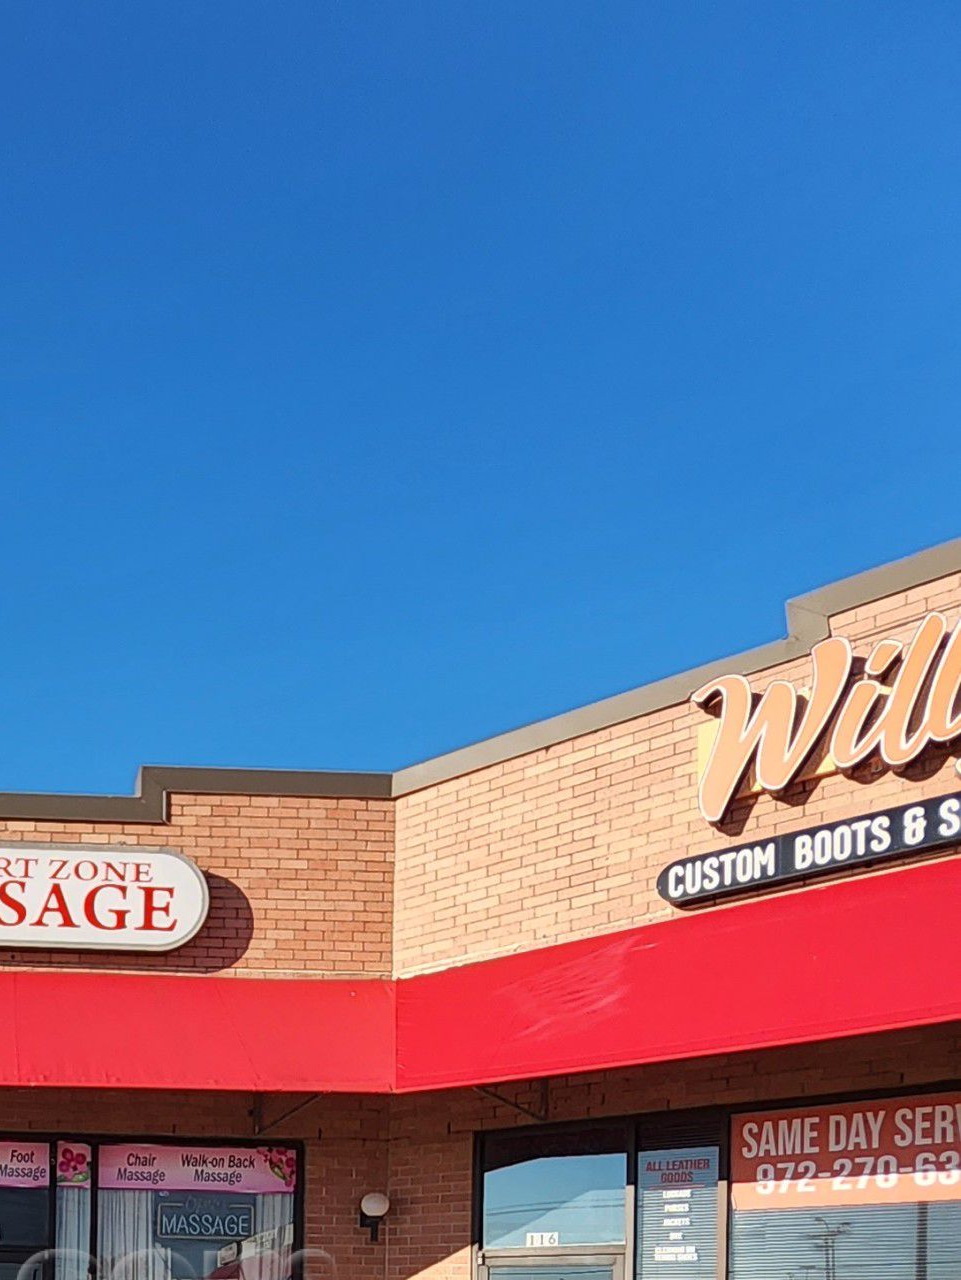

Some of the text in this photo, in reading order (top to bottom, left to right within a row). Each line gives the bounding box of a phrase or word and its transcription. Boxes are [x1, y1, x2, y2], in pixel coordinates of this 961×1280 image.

[668, 843, 776, 898] CUSTOM
[794, 816, 891, 870] BOOTS
[903, 806, 927, 846] &
[49, 859, 154, 882] ZONE
[742, 1116, 820, 1158] SAME
[829, 1110, 886, 1152] DAY
[10, 1149, 34, 1163] Foot
[126, 1153, 255, 1169] Chair Walk-on Back
[646, 1159, 710, 1171] ALL LEATHER
[116, 1168, 242, 1185] Massage Massage
[661, 1171, 694, 1183] GOODS
[162, 1214, 249, 1236] MASSAGE
[530, 1234, 556, 1246] 116
